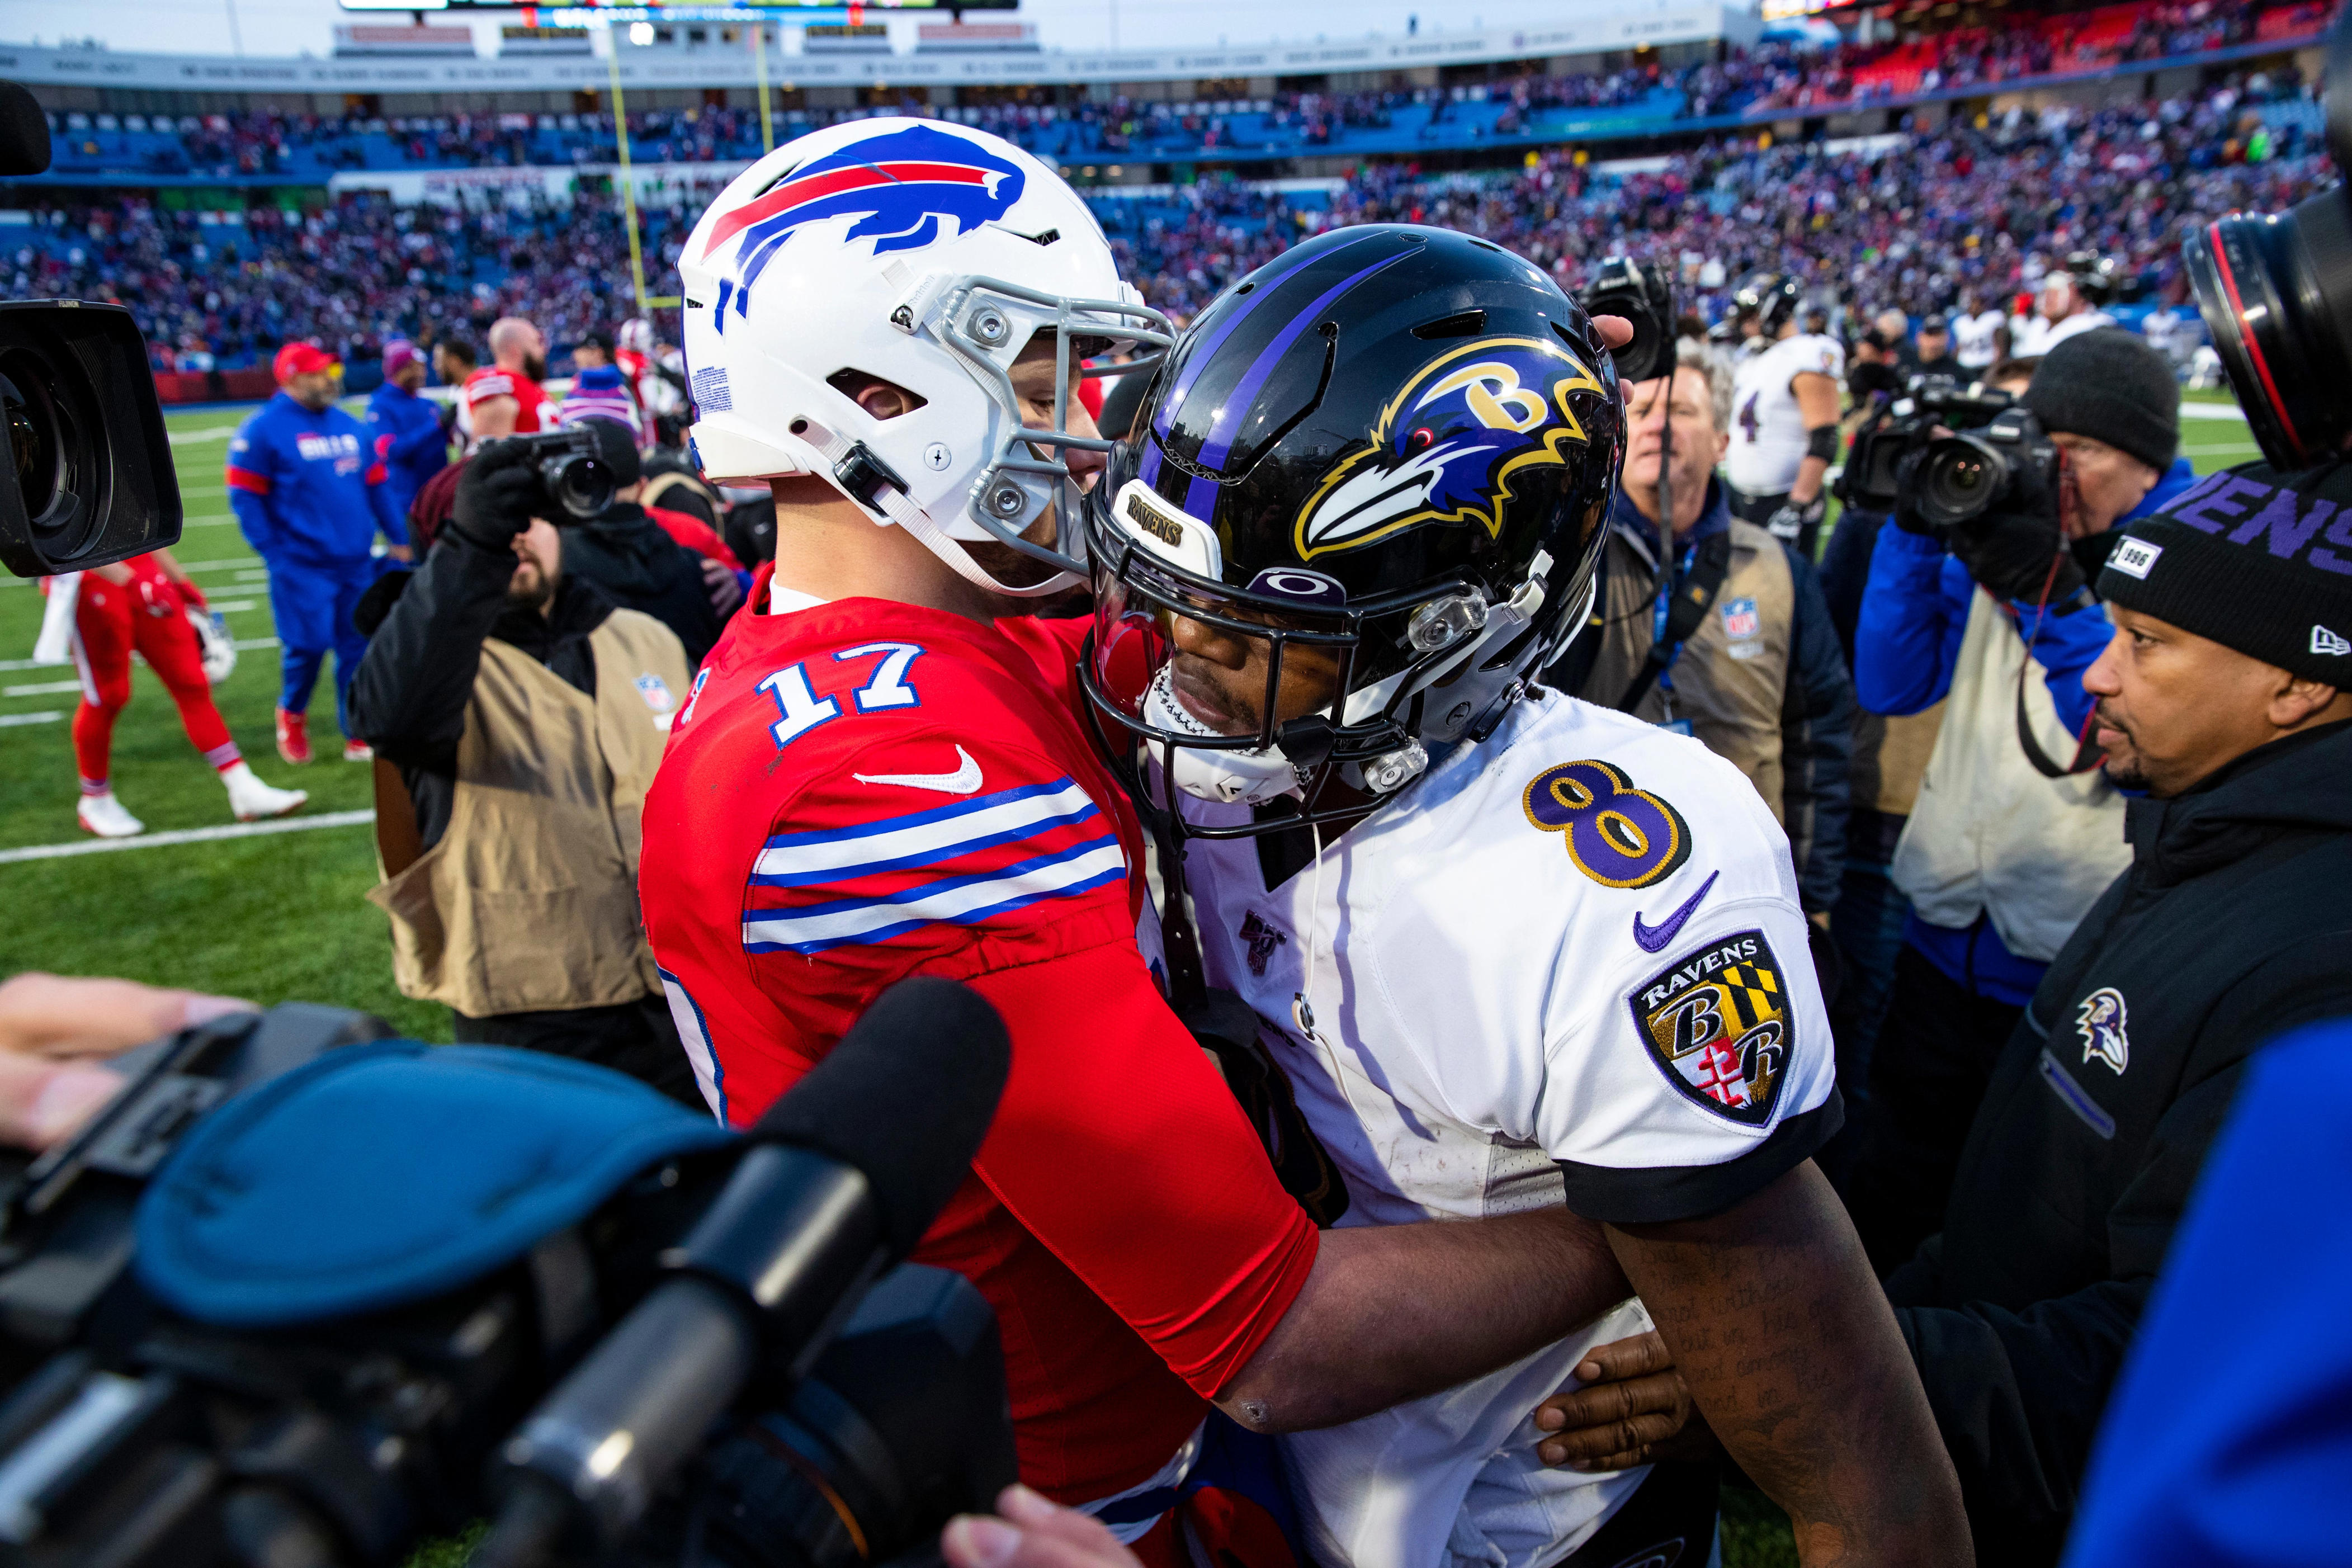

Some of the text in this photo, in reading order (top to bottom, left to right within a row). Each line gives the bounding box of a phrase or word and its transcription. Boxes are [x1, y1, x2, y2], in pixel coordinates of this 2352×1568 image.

[1127, 494, 1183, 547] RAVENS
[753, 641, 927, 752] 17
[1522, 759, 1692, 889] 8
[1641, 939, 1758, 1009] RAVENS
[1653, 986, 1722, 1057] B
[1734, 1020, 1783, 1085] R
